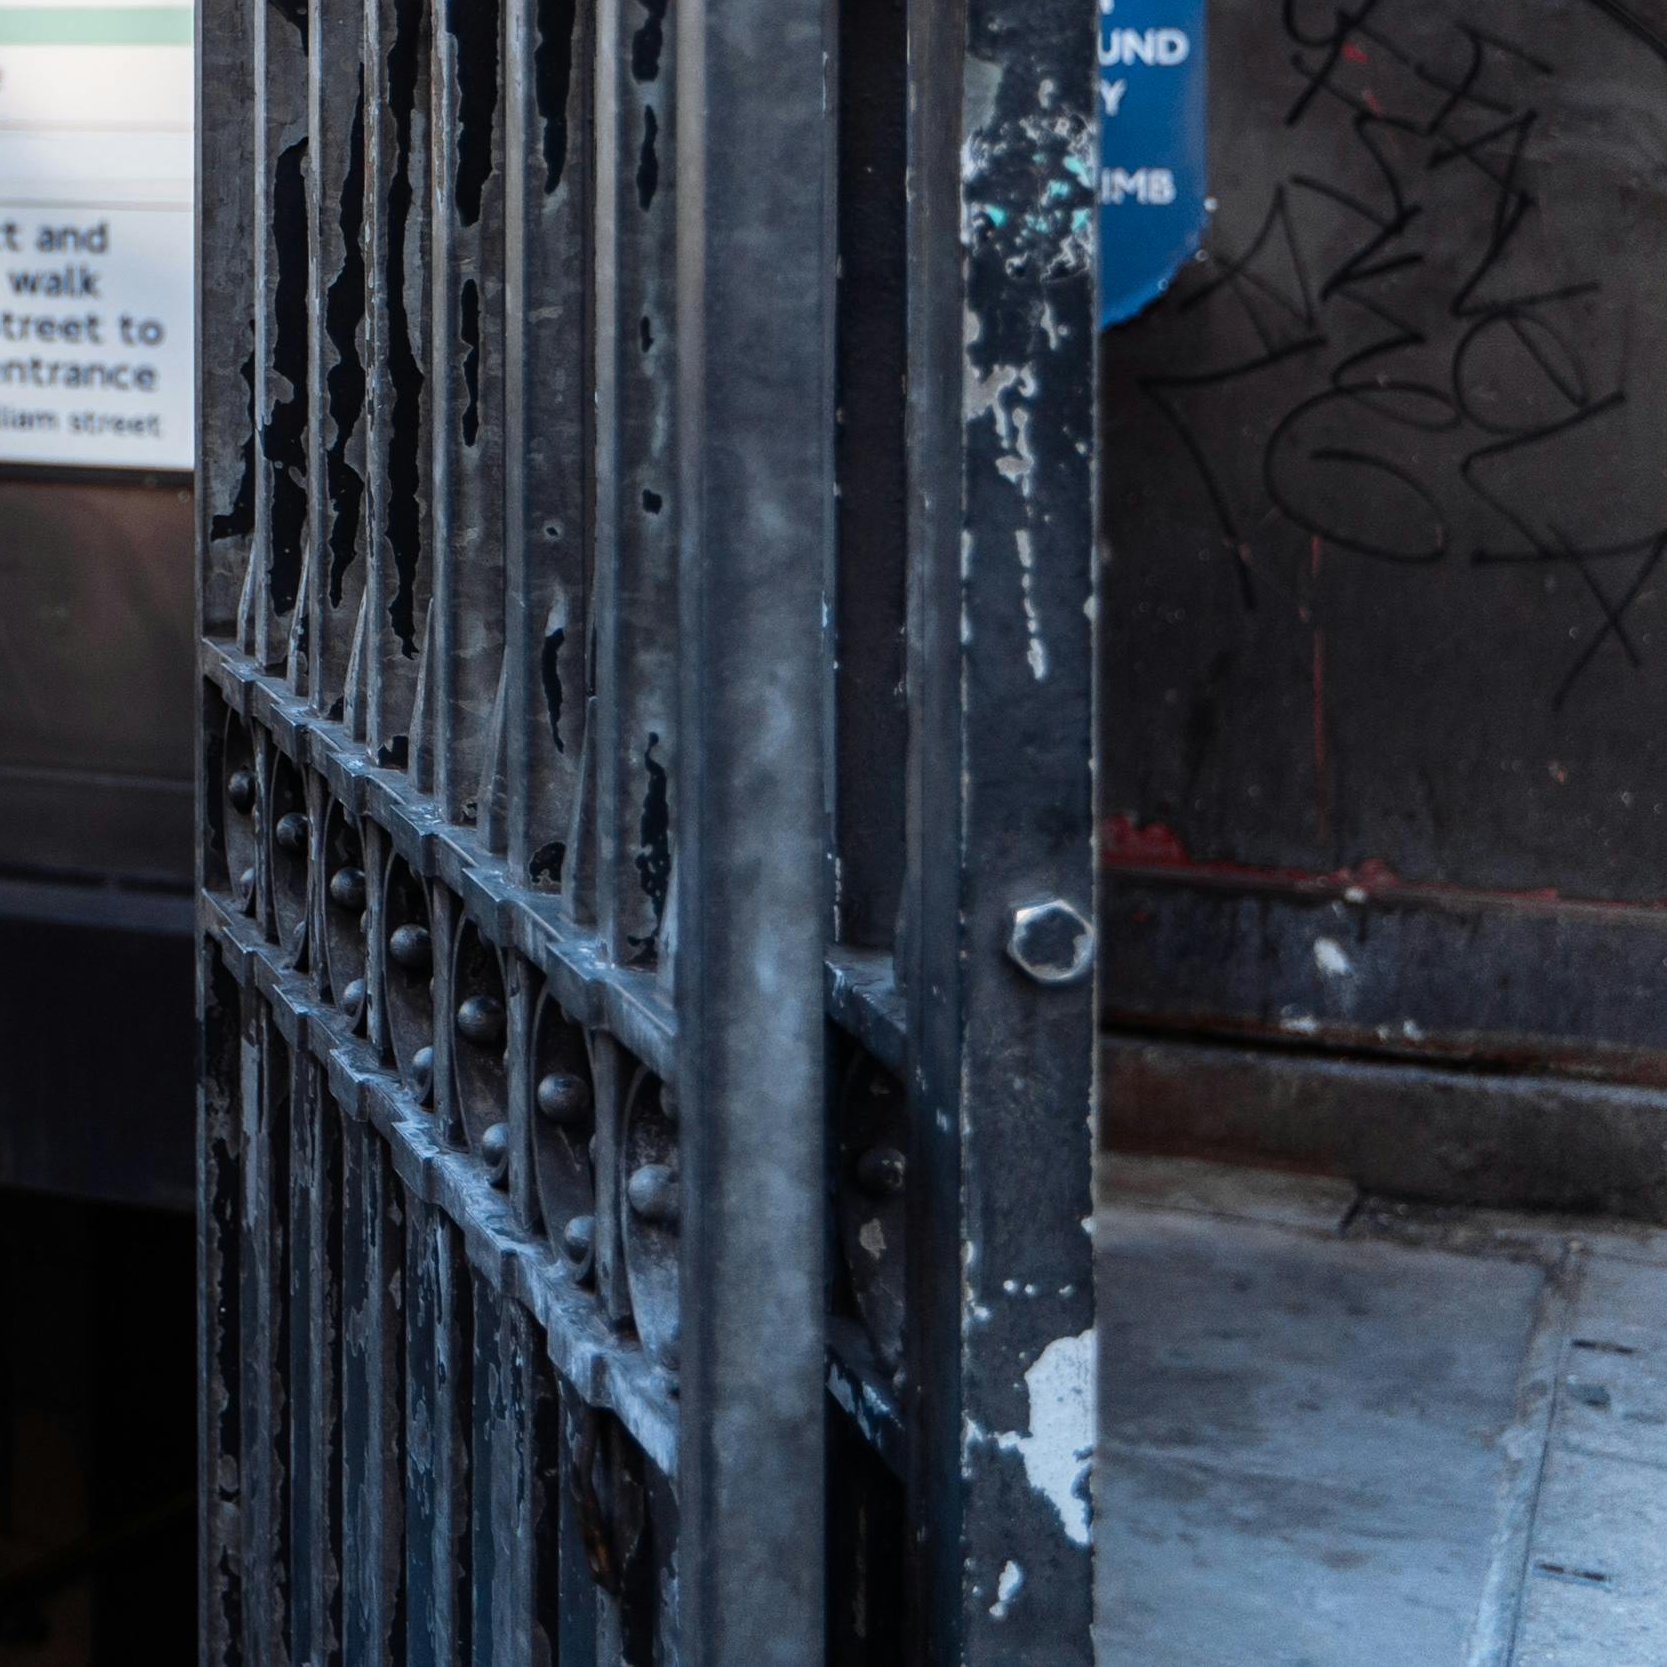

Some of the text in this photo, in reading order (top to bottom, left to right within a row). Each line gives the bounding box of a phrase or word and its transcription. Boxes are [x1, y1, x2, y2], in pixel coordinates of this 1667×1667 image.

[37, 222, 109, 254] and
[8, 263, 100, 298] walk
[119, 315, 167, 347] to
[70, 409, 161, 436] street
